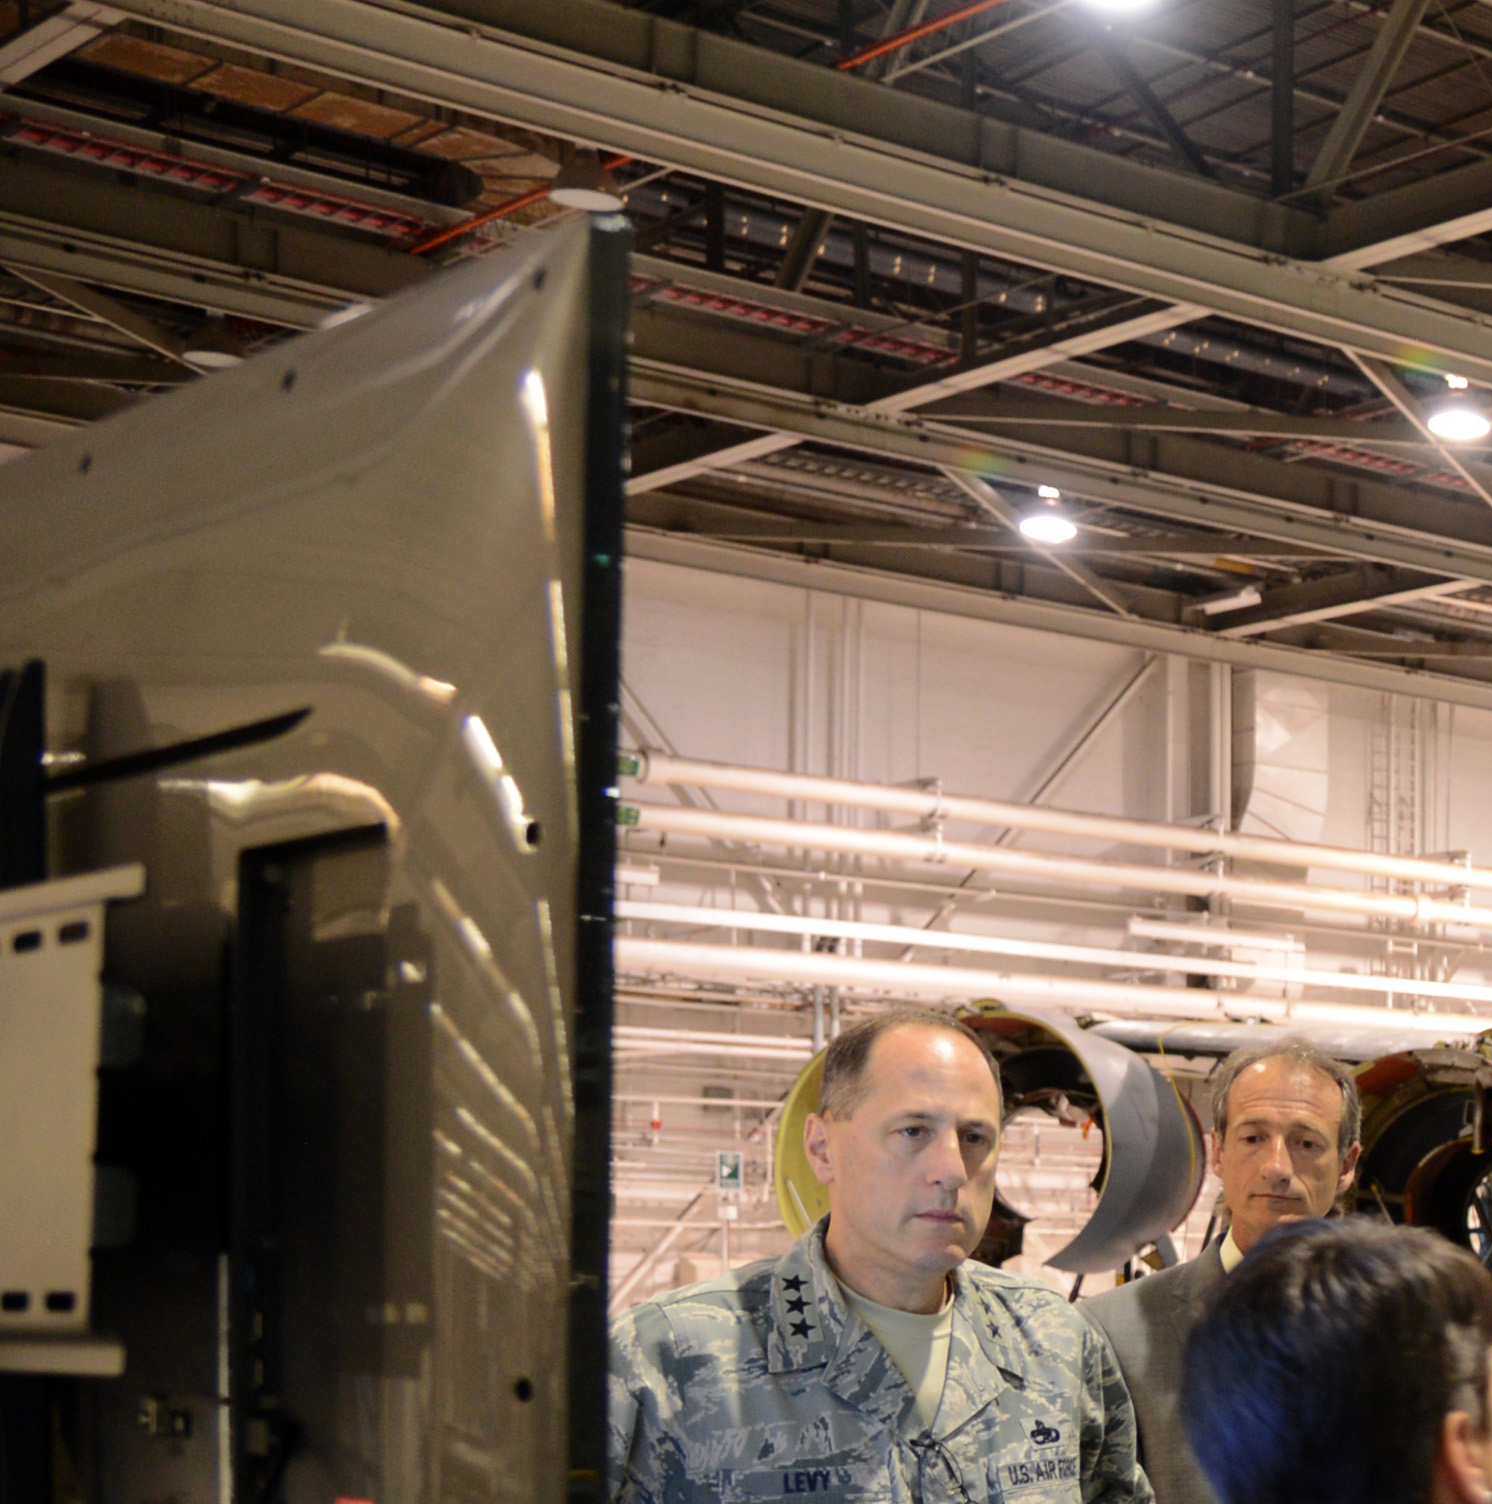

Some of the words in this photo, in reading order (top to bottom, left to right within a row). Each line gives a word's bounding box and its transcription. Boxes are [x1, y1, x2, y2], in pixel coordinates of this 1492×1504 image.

[783, 1470, 830, 1493] LEVY
[1008, 1464, 1033, 1486] U.S.
[1036, 1460, 1057, 1481] AIR
